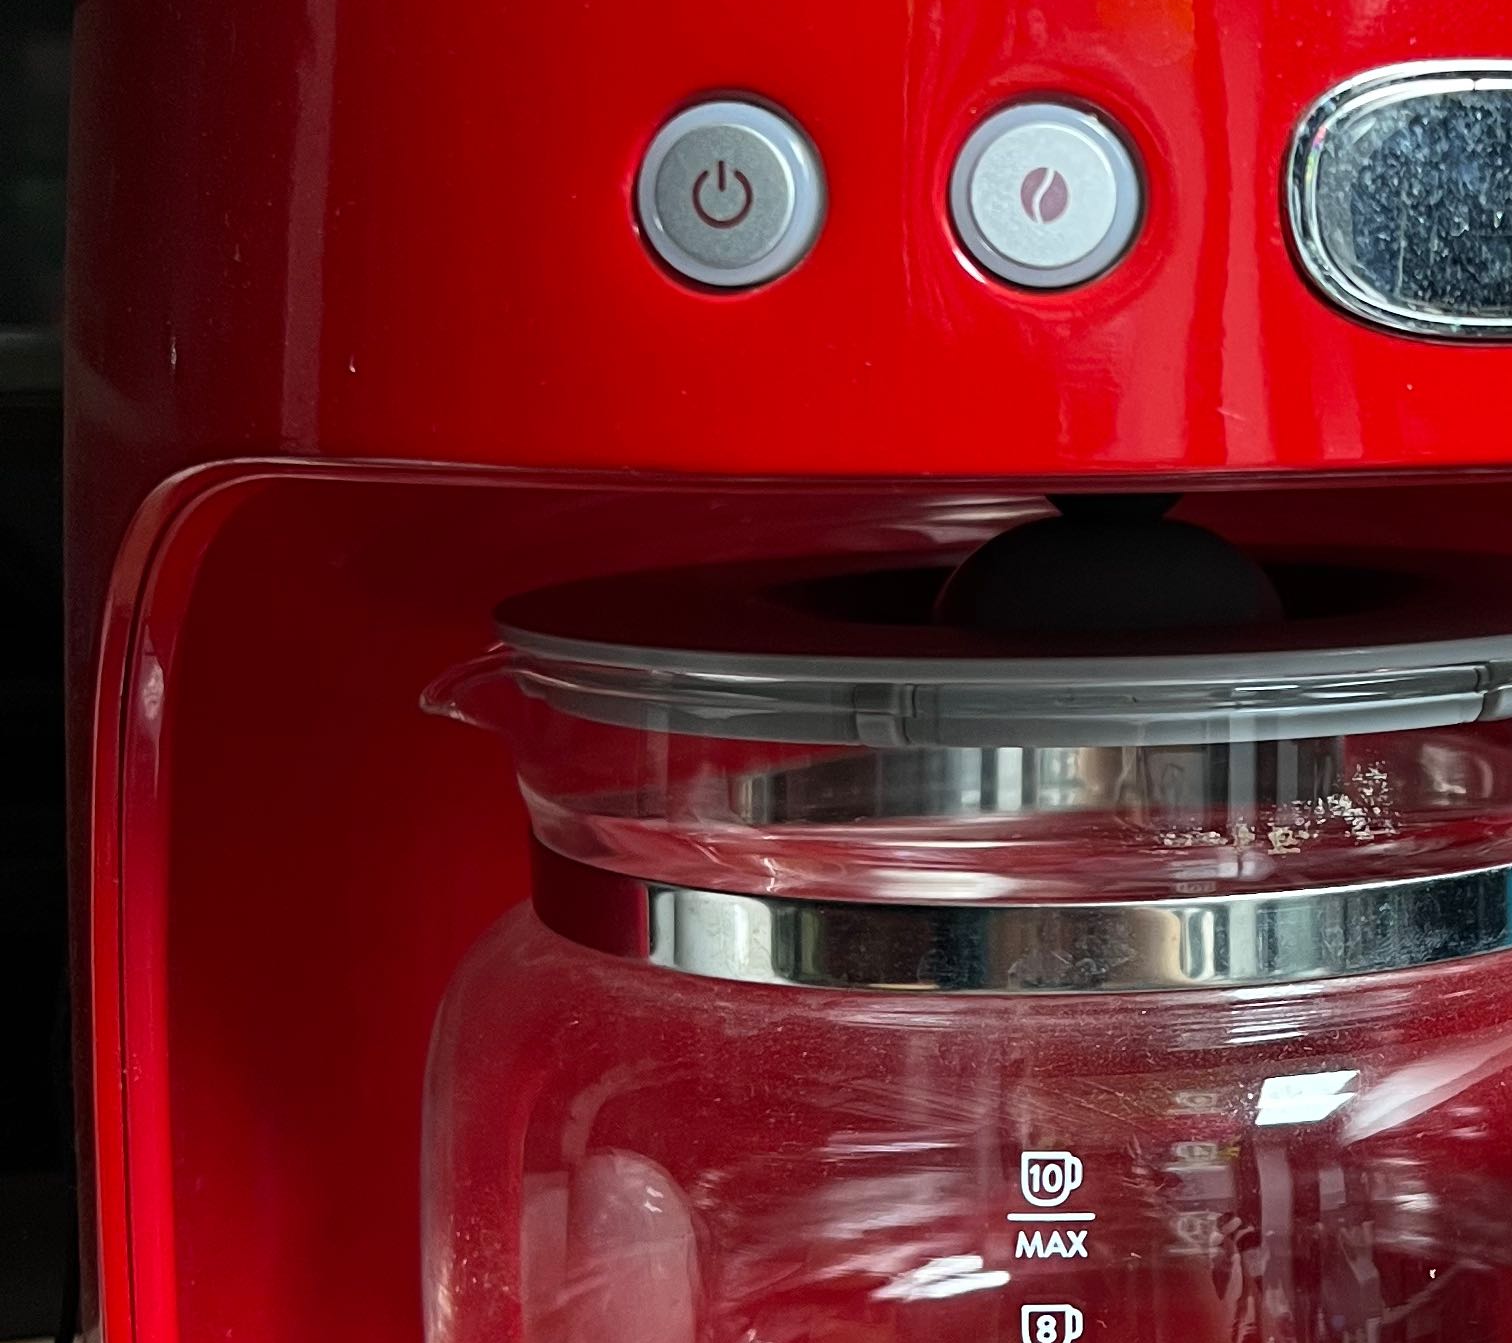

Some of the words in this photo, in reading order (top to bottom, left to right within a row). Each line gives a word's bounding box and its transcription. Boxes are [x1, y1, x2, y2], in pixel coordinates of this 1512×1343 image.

[1029, 1163, 1063, 1193] 10
[1015, 1230, 1088, 1258] MAX
[1036, 1314, 1057, 1343] 8
